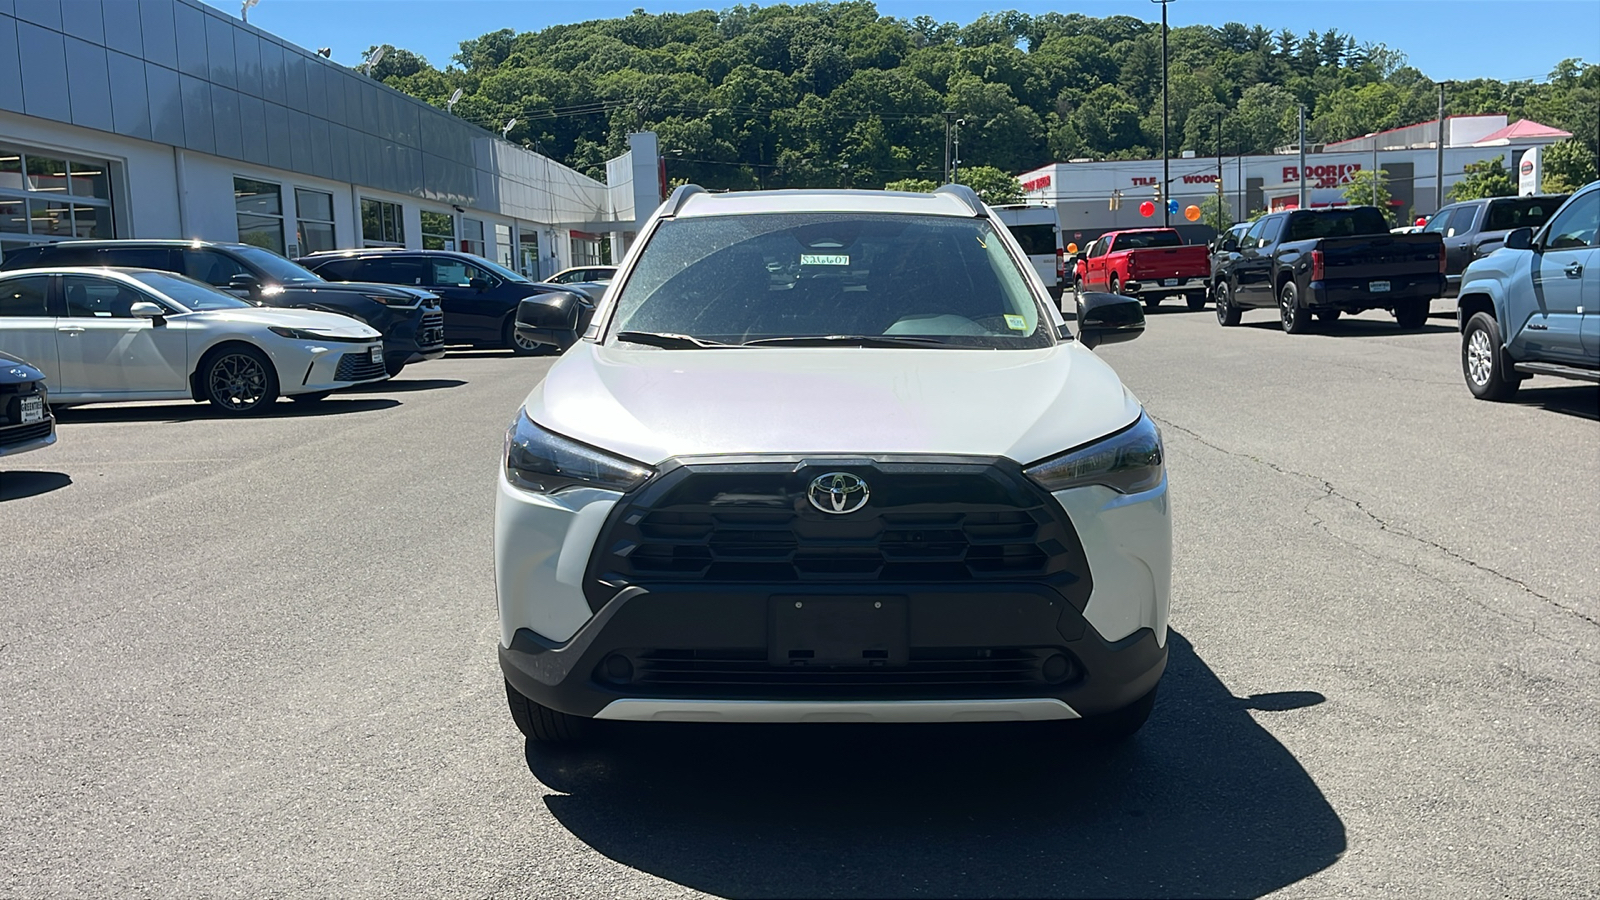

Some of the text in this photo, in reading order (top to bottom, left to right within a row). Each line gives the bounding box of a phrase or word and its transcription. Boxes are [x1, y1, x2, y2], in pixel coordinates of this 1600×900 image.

[1283, 165, 1337, 178] FLOOR
[1131, 177, 1156, 186] TILE
[1183, 175, 1218, 184] WOOD
